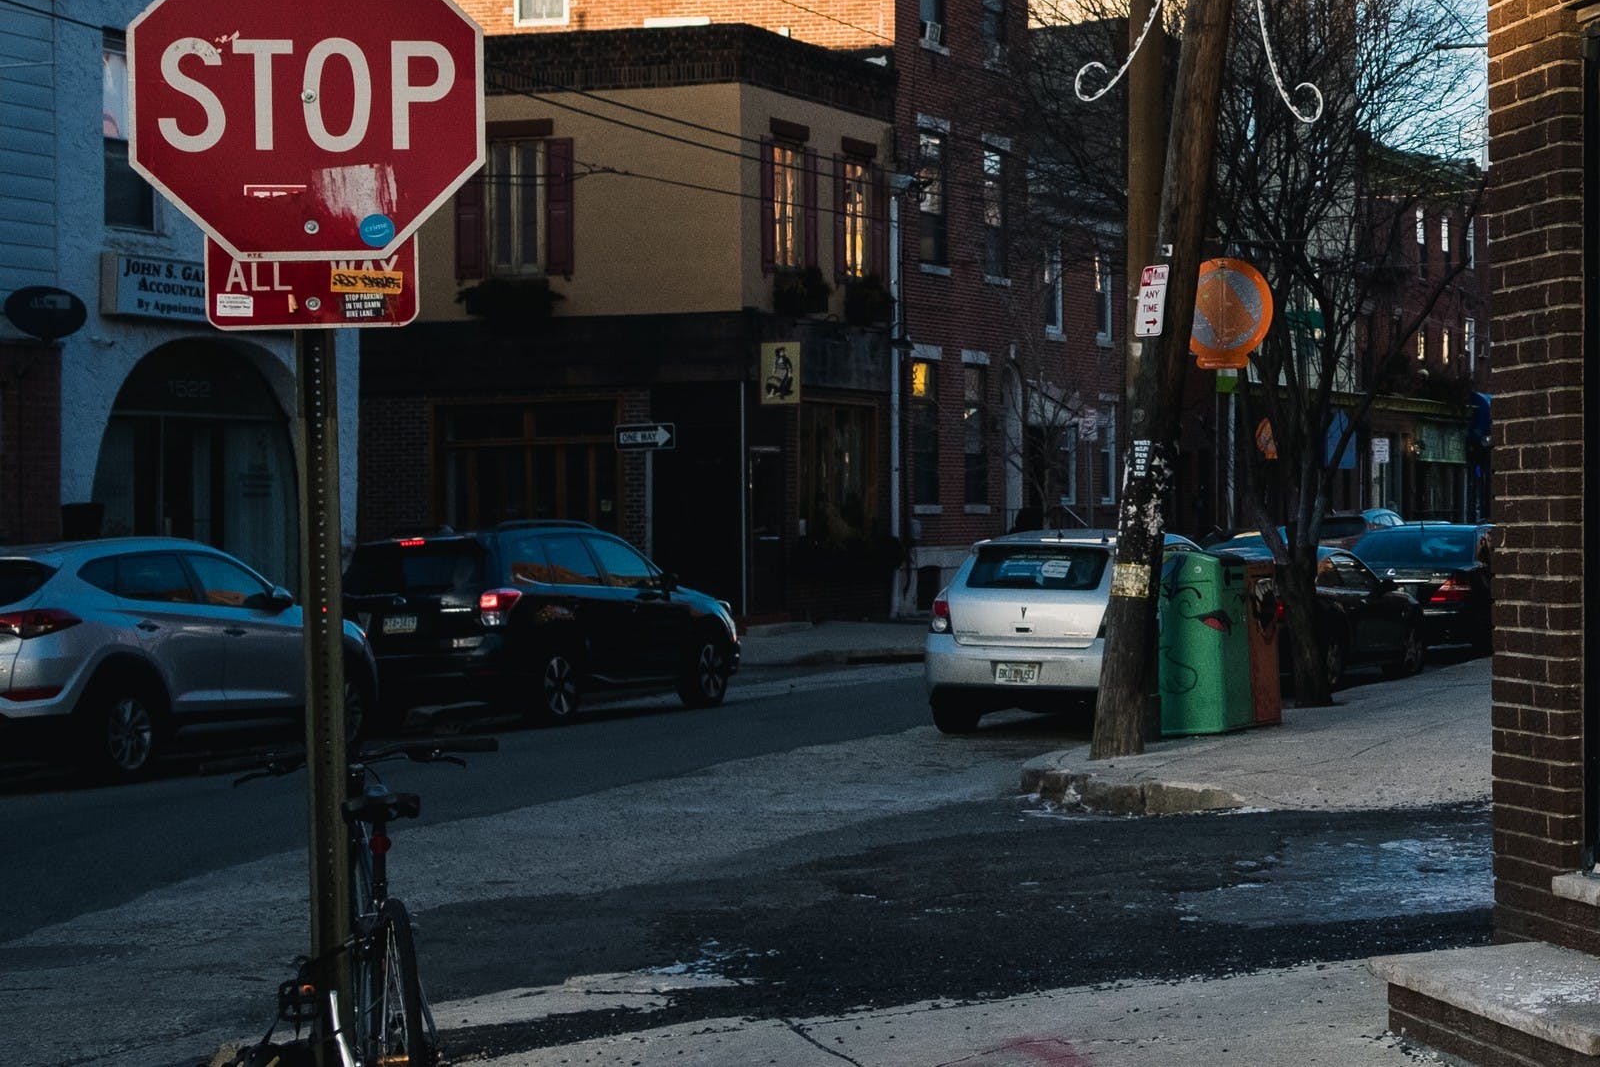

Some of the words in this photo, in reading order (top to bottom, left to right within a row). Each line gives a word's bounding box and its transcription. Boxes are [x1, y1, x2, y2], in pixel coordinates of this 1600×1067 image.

[157, 36, 456, 153] STOP
[123, 258, 162, 277] JOHN
[165, 263, 178, 279] S.
[224, 259, 293, 293] ALL
[345, 293, 360, 302] STOP
[1144, 289, 1160, 299] ANY
[137, 298, 150, 312] By
[1143, 303, 1159, 313] TIME
[346, 310, 358, 318] BIKE
[168, 379, 212, 398] 1522
[622, 432, 638, 443] ONE
[640, 431, 656, 441] WAY
